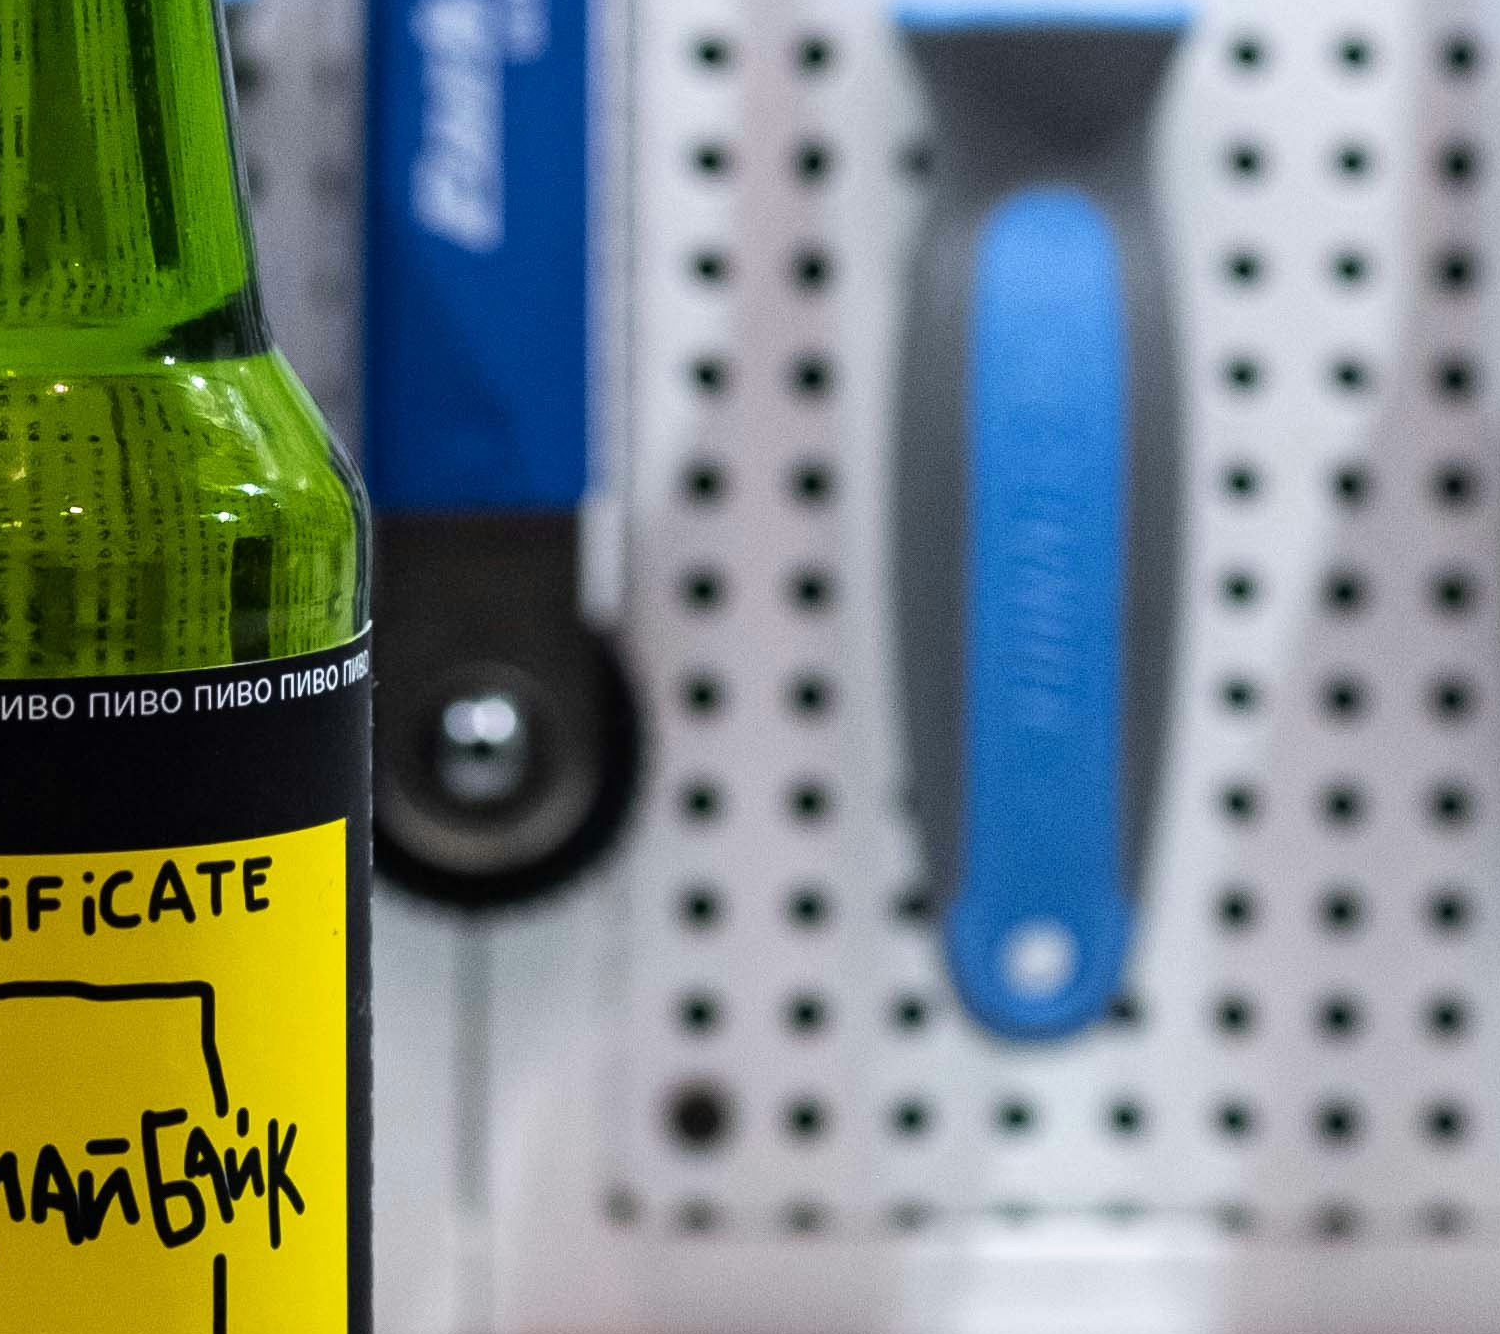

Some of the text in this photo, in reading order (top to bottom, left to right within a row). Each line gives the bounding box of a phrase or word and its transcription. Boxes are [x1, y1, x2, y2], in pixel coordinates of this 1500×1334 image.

[89, 688, 183, 718] ПИВО
[194, 677, 272, 712] ПИВО
[280, 664, 339, 701] ПИВО
[343, 649, 369, 687] ПИВО
